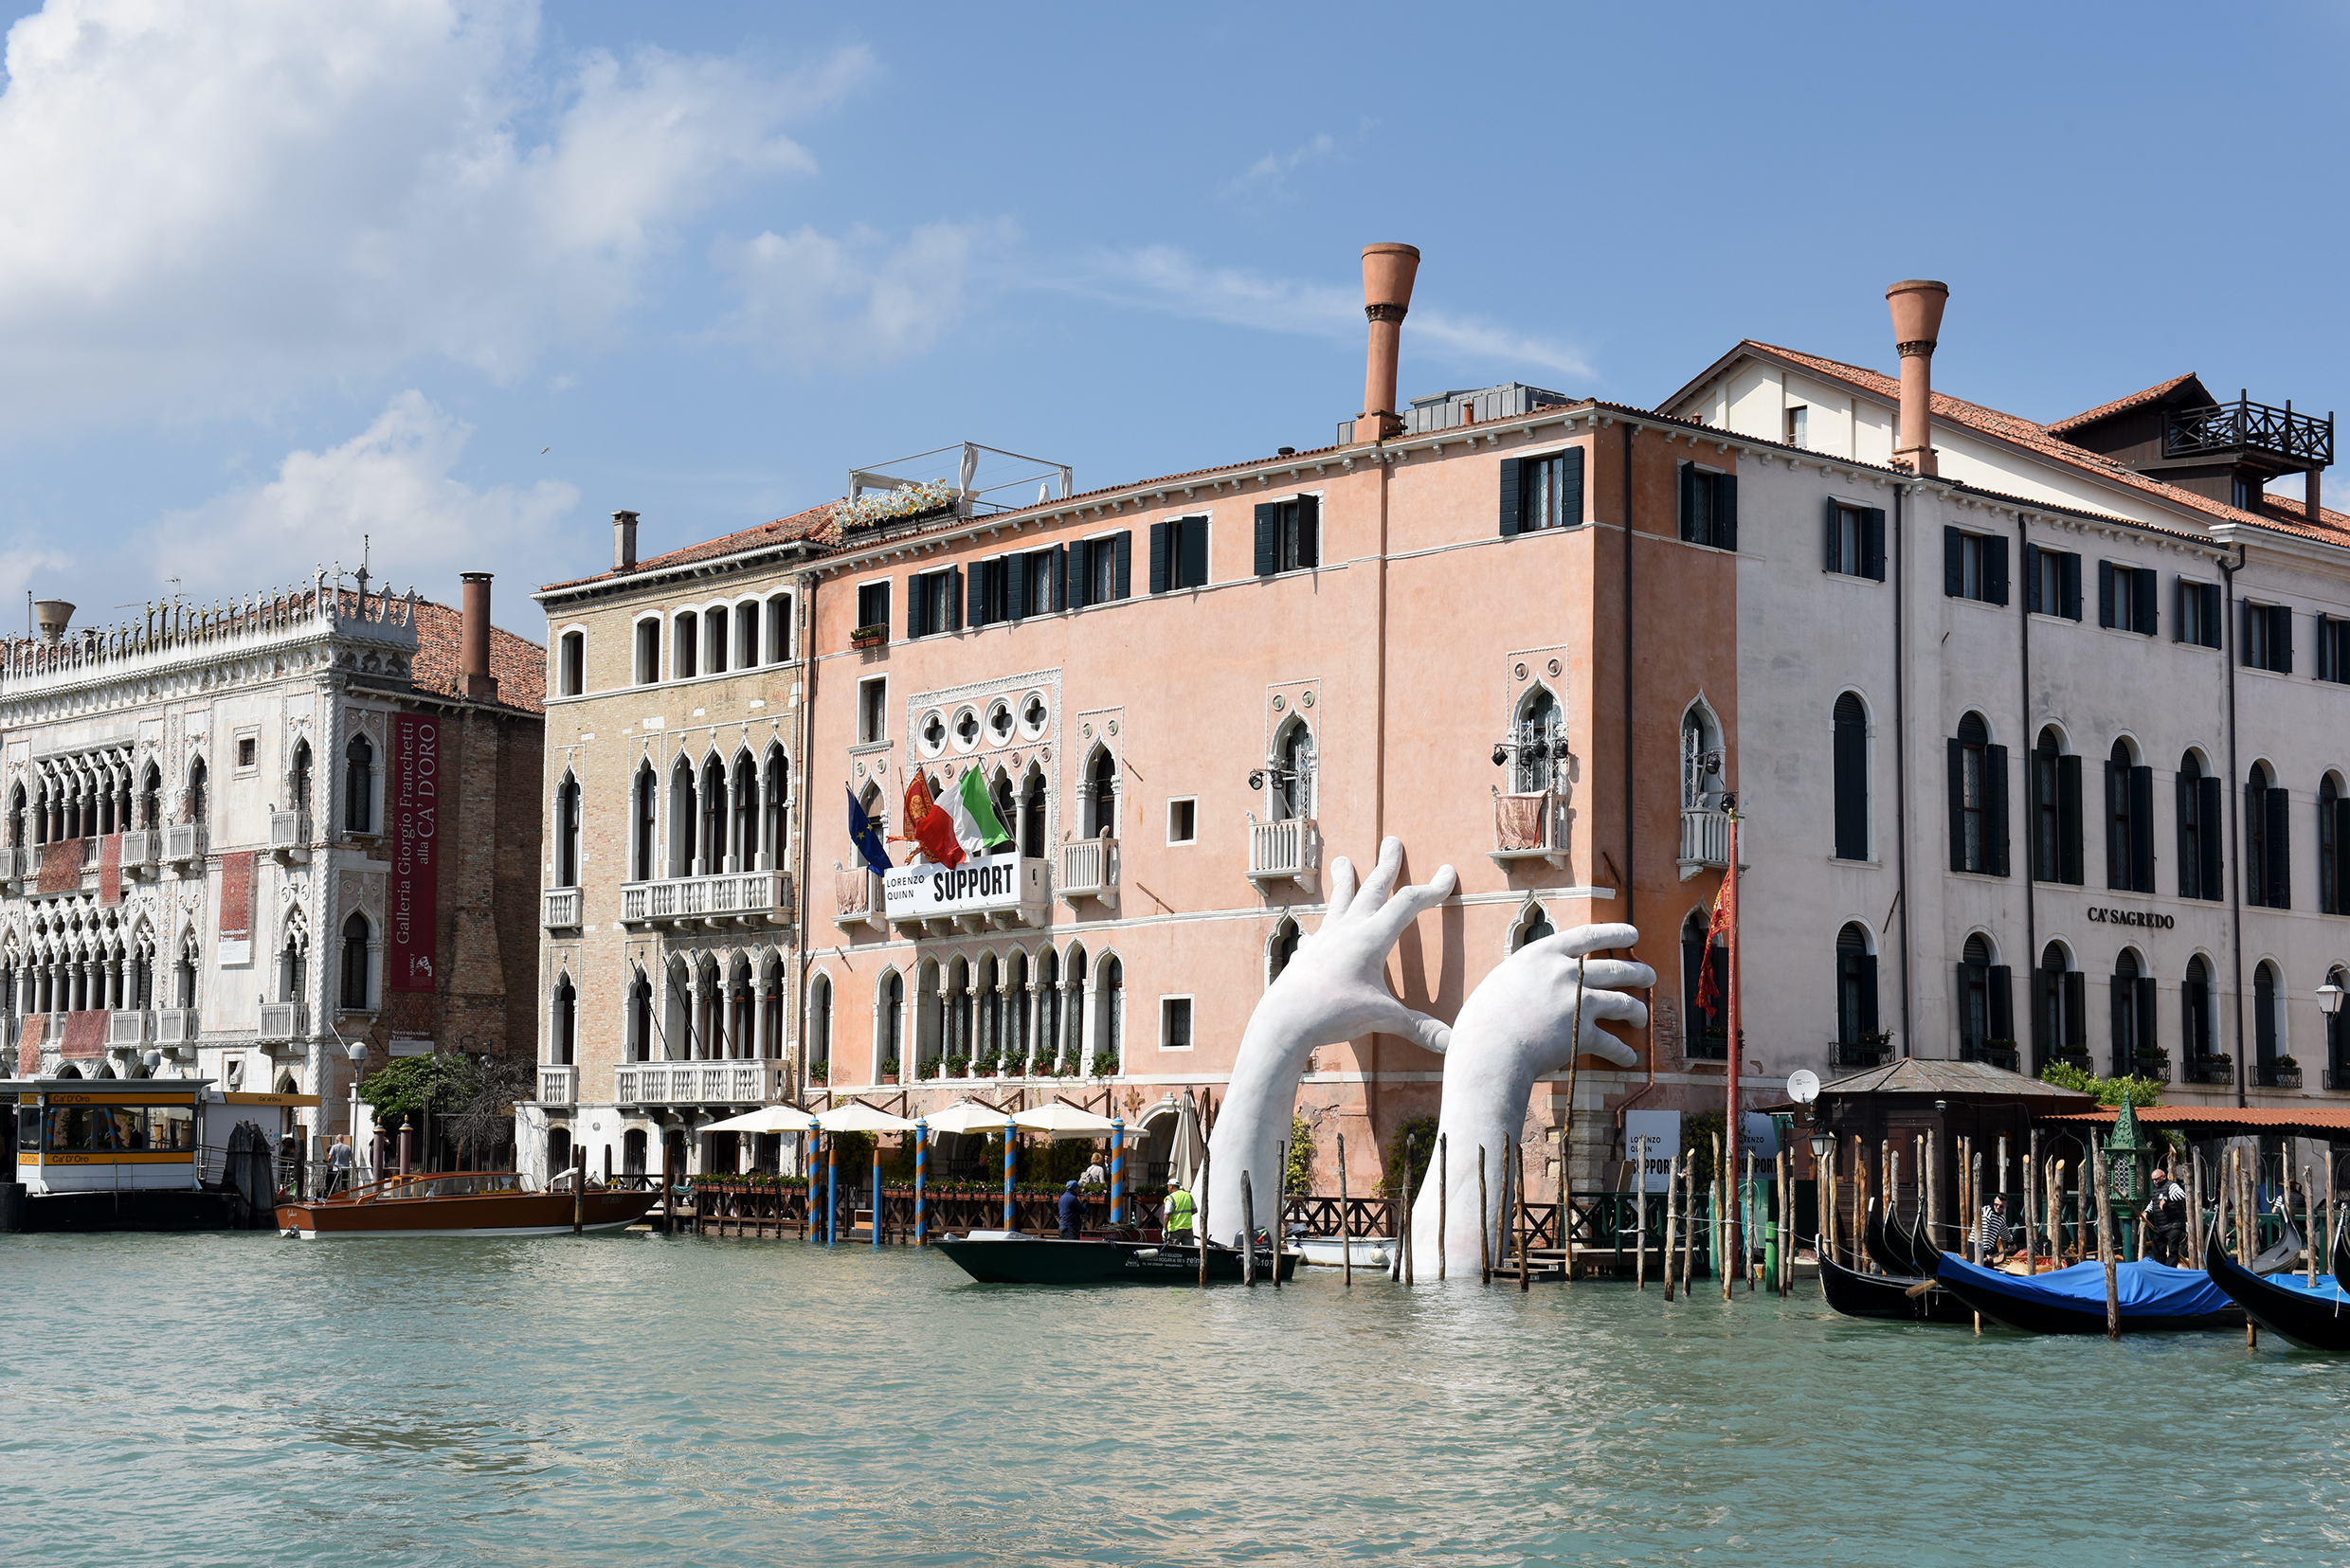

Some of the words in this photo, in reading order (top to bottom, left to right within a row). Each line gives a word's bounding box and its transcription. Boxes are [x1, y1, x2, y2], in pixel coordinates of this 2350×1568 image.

[400, 722, 414, 808] Franchetti
[418, 724, 436, 797] D'ORO
[398, 813, 416, 875] Giorgio
[418, 841, 429, 865] alla
[886, 874, 925, 888] LORENZO
[933, 864, 1013, 902] SUPPORT
[887, 889, 914, 901] QUINN
[396, 880, 410, 945] Galleria
[2088, 907, 2108, 923] CA'
[2110, 910, 2175, 929] SAGREDO
[53, 1094, 65, 1103] Ca'
[66, 1094, 91, 1103] D'Oro
[52, 1155, 64, 1163] Ca'
[65, 1154, 89, 1163] D'Oro
[1631, 1158, 1672, 1175] SPPOR
[1738, 1158, 1778, 1174] UPORT
